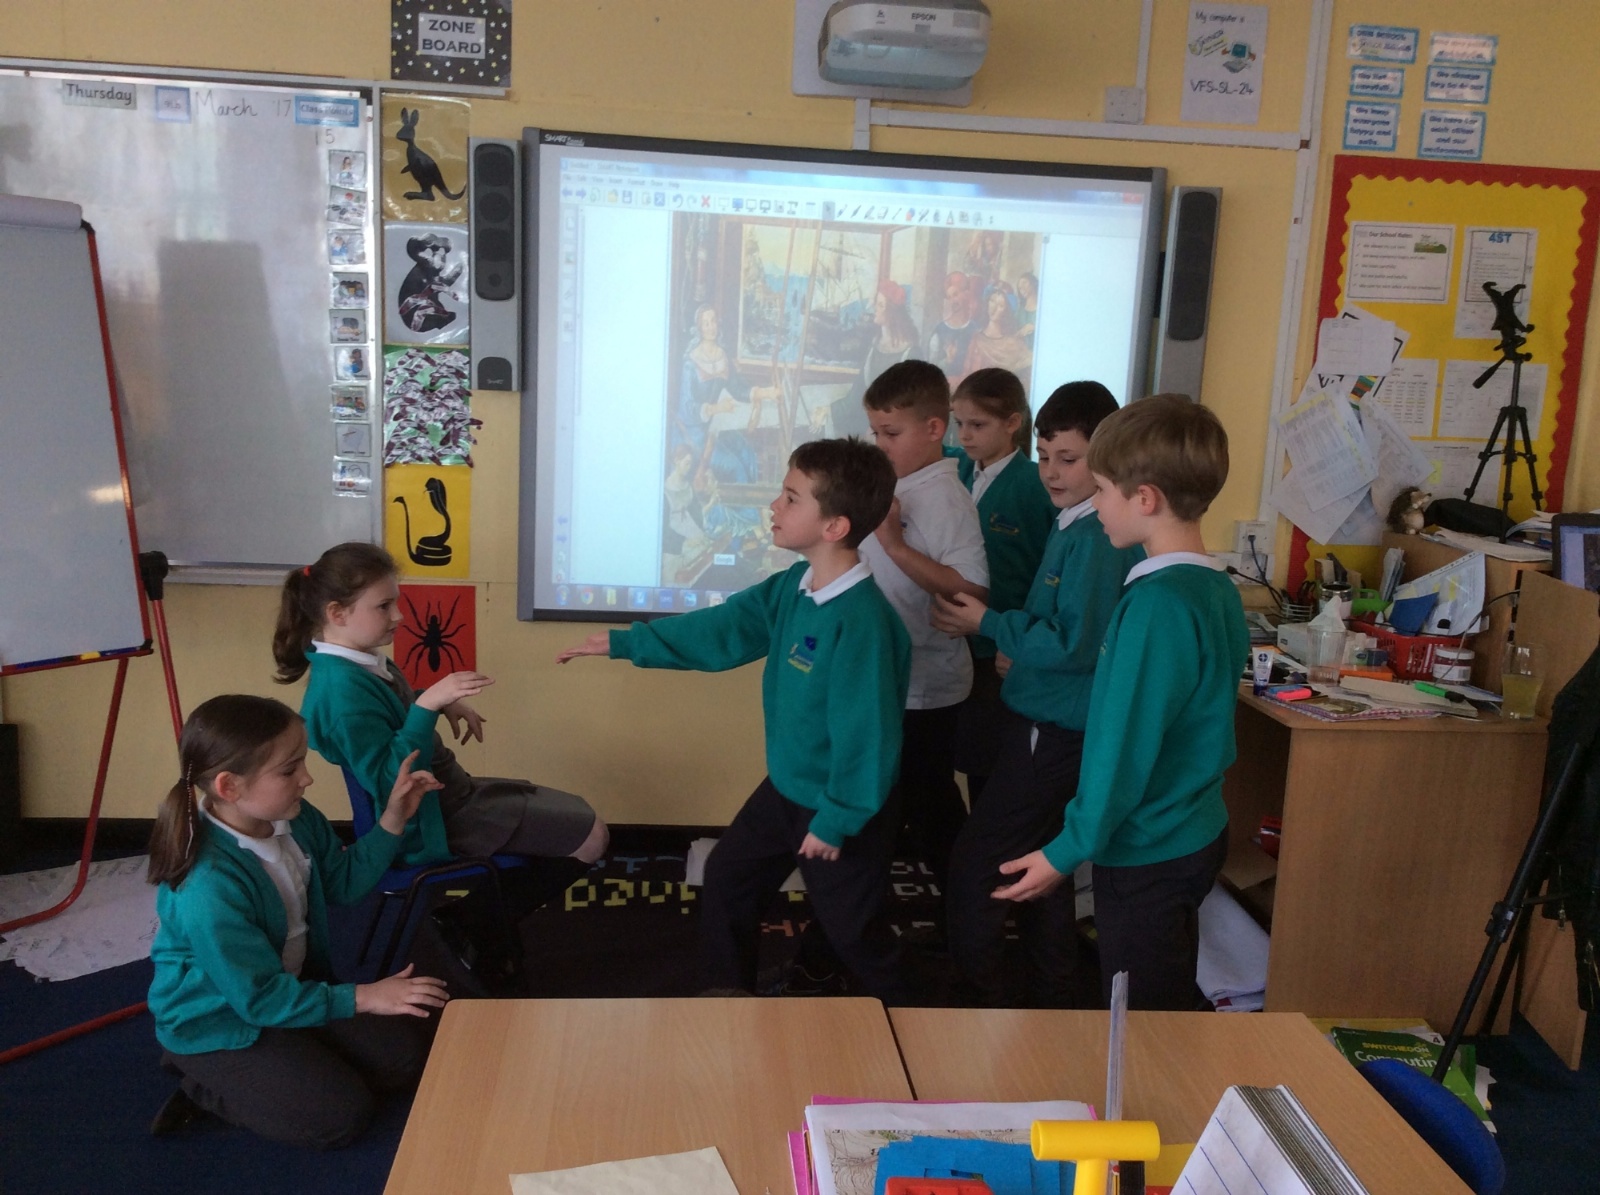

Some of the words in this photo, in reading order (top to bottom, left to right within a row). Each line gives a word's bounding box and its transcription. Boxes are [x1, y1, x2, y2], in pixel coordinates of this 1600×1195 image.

[911, 12, 936, 21] EPSON
[428, 19, 476, 34] ZONE
[422, 38, 482, 54] BOARD
[66, 83, 132, 106] Thursday
[1190, 80, 1254, 95] VFS-SL-24
[195, 90, 258, 117] March
[544, 133, 568, 143] SMART
